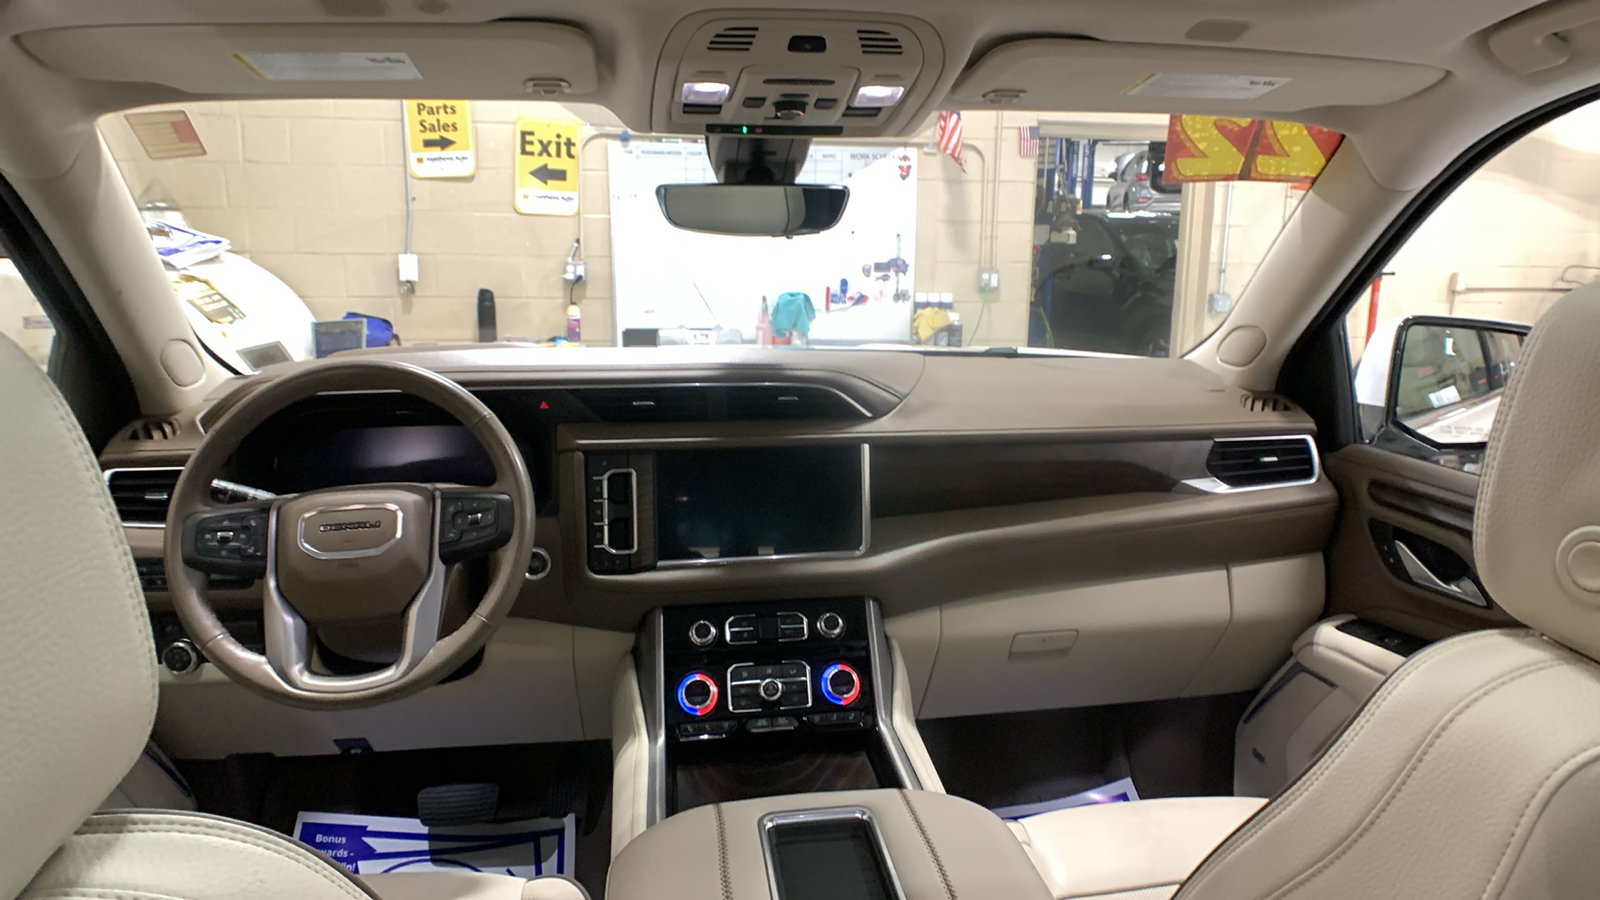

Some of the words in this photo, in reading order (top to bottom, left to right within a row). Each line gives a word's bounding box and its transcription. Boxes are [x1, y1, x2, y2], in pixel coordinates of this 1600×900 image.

[416, 102, 457, 116] Parts
[418, 118, 459, 134] Sales
[519, 129, 577, 160] Exit
[315, 833, 347, 844] Bonus
